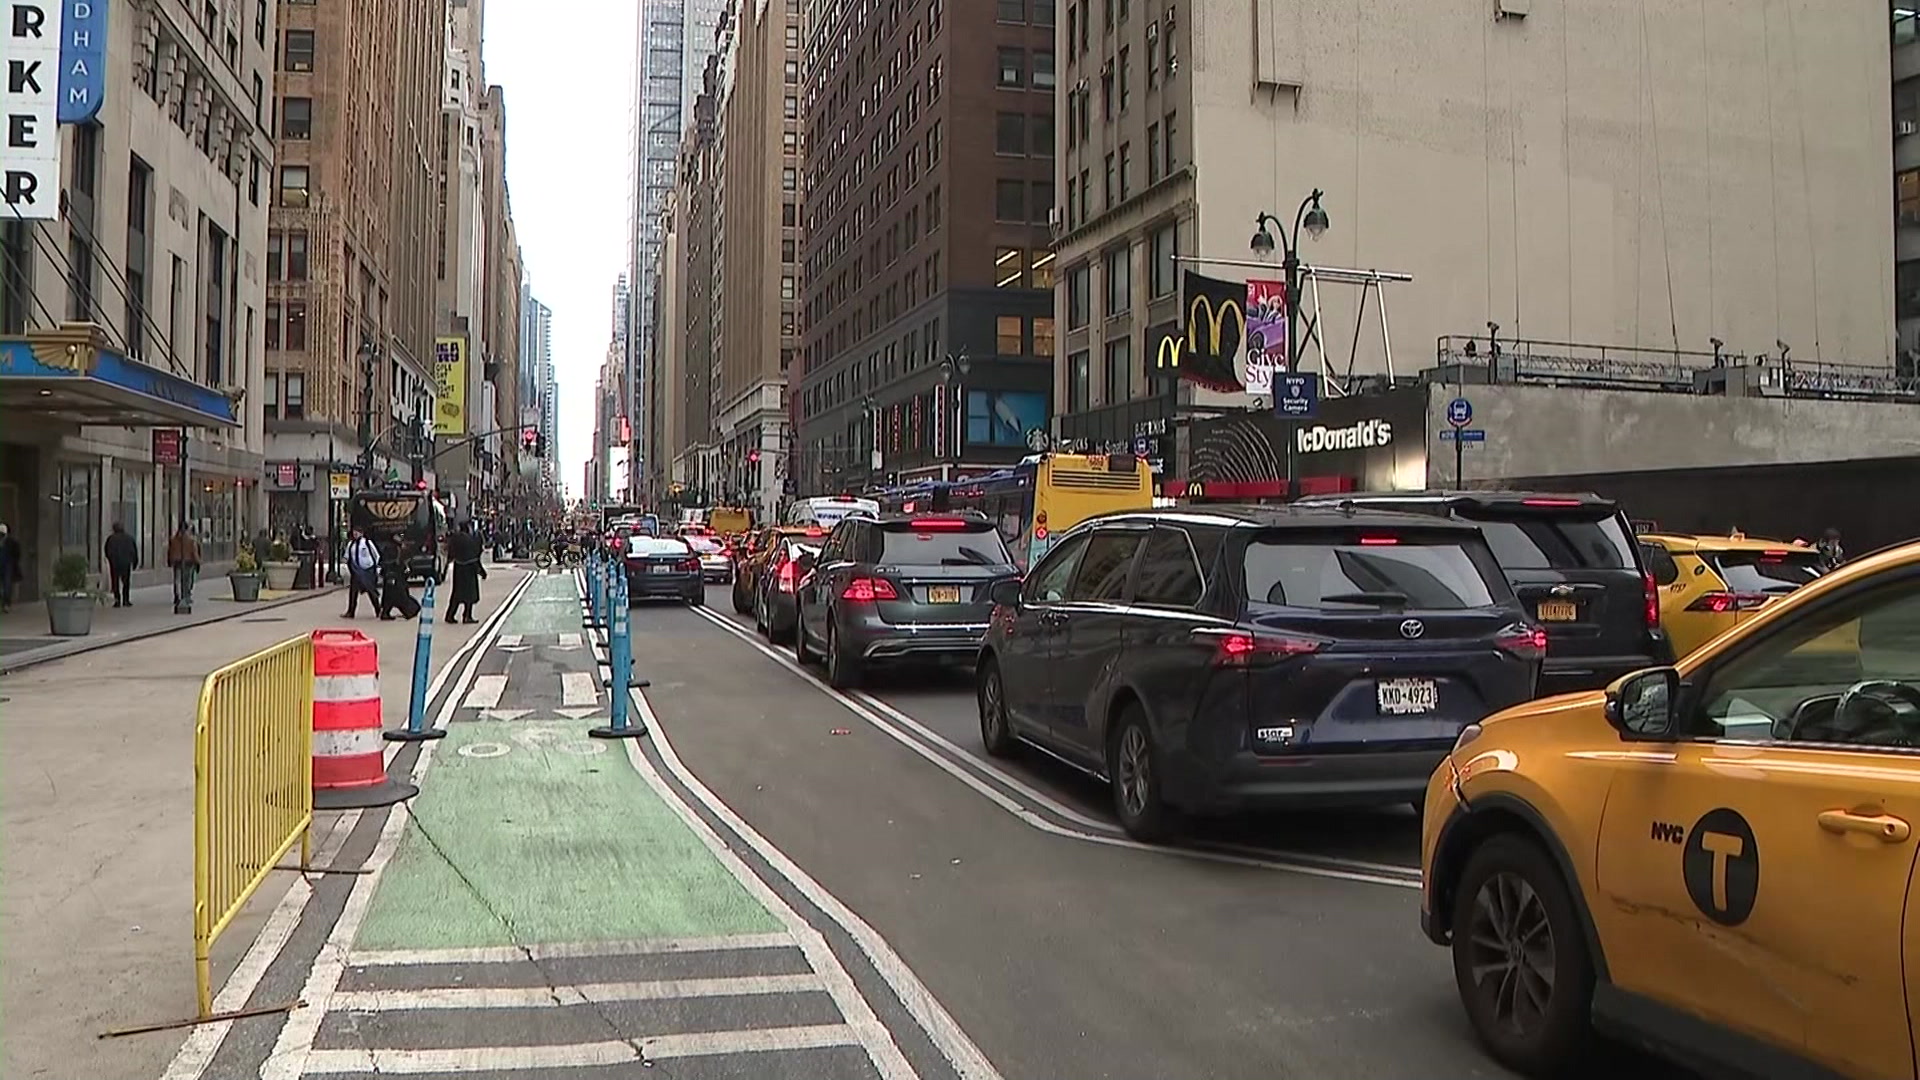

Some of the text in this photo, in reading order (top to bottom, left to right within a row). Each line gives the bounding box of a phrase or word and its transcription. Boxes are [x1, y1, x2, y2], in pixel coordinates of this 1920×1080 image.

[1247, 348, 1284, 366] Give
[1246, 367, 1273, 388] Sty
[1286, 377, 1305, 385] NYPD
[1283, 397, 1308, 406] Security
[1651, 821, 1684, 845] NYC
[1702, 831, 1743, 912] T
